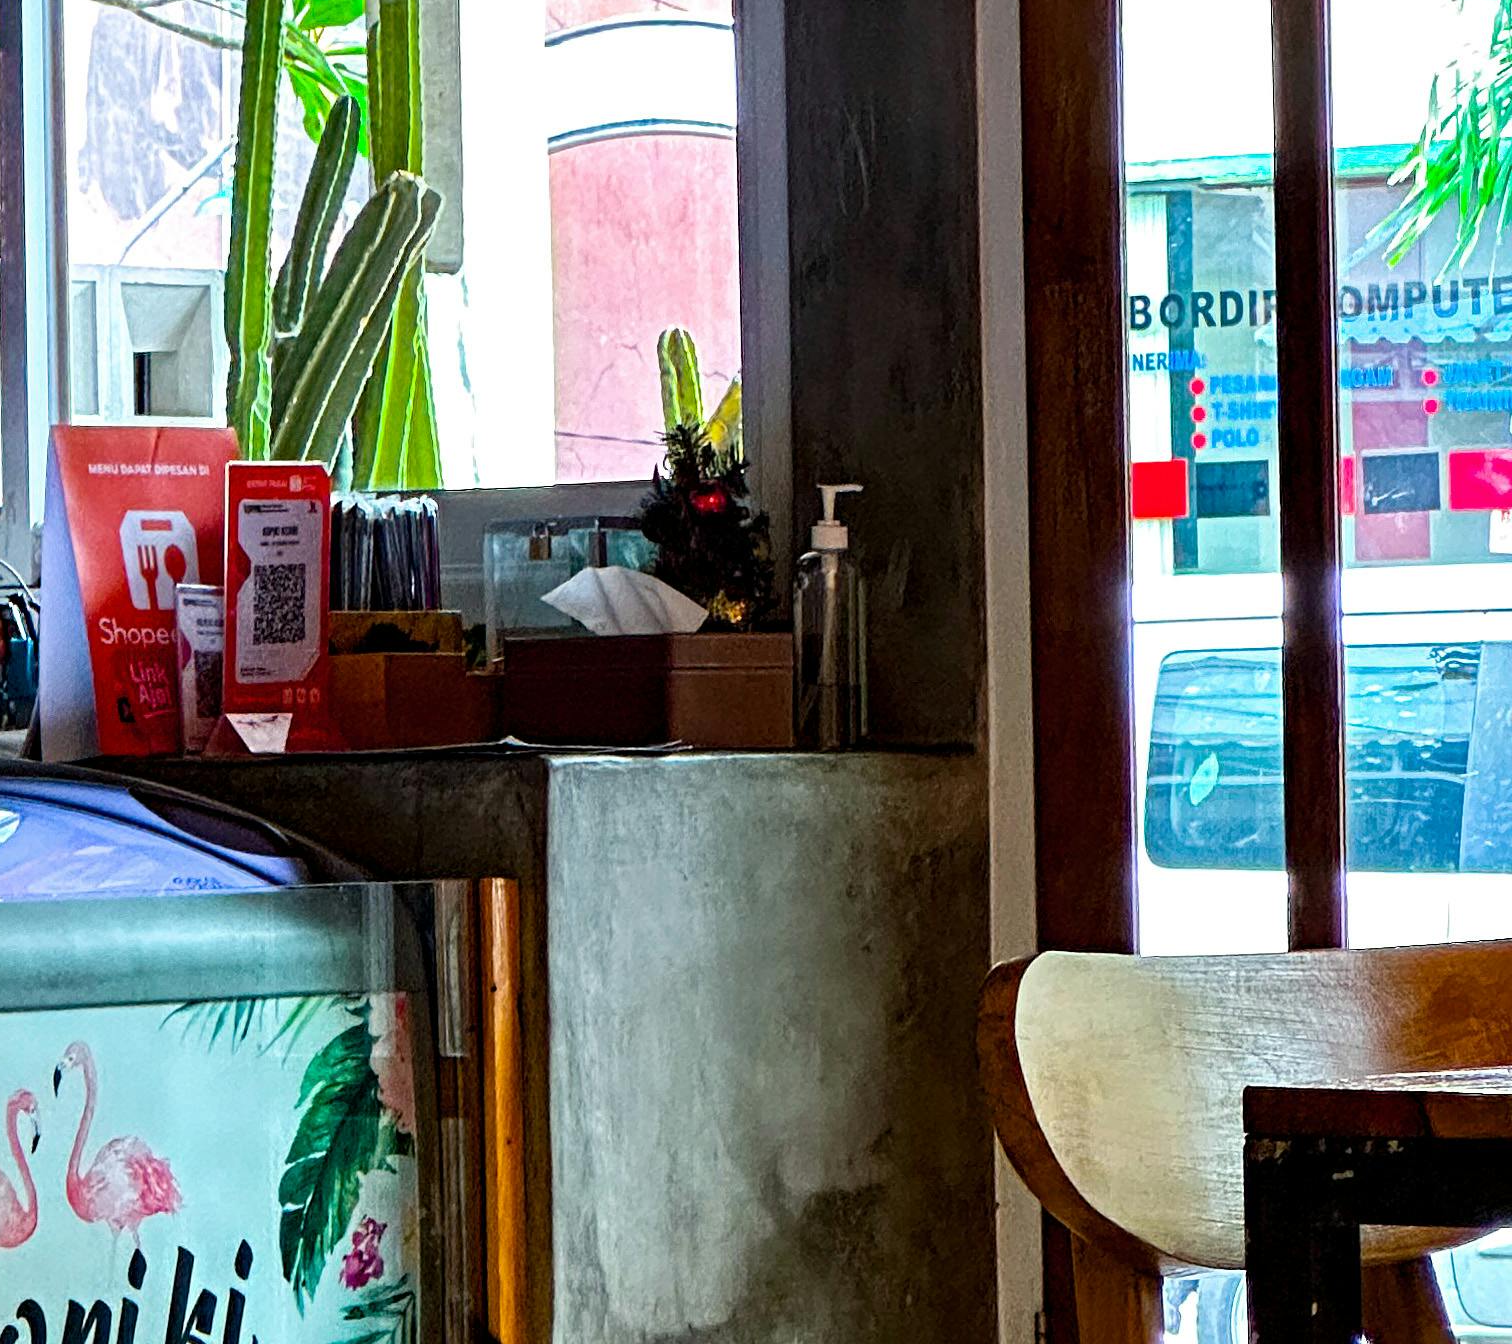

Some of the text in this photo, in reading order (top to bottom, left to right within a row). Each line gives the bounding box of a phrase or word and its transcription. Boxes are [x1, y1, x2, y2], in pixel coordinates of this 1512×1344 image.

[1339, 276, 1512, 322] OMPUTE
[1211, 427, 1260, 448] POLO
[88, 463, 209, 476] MENU DAPAT DIPESAN DI
